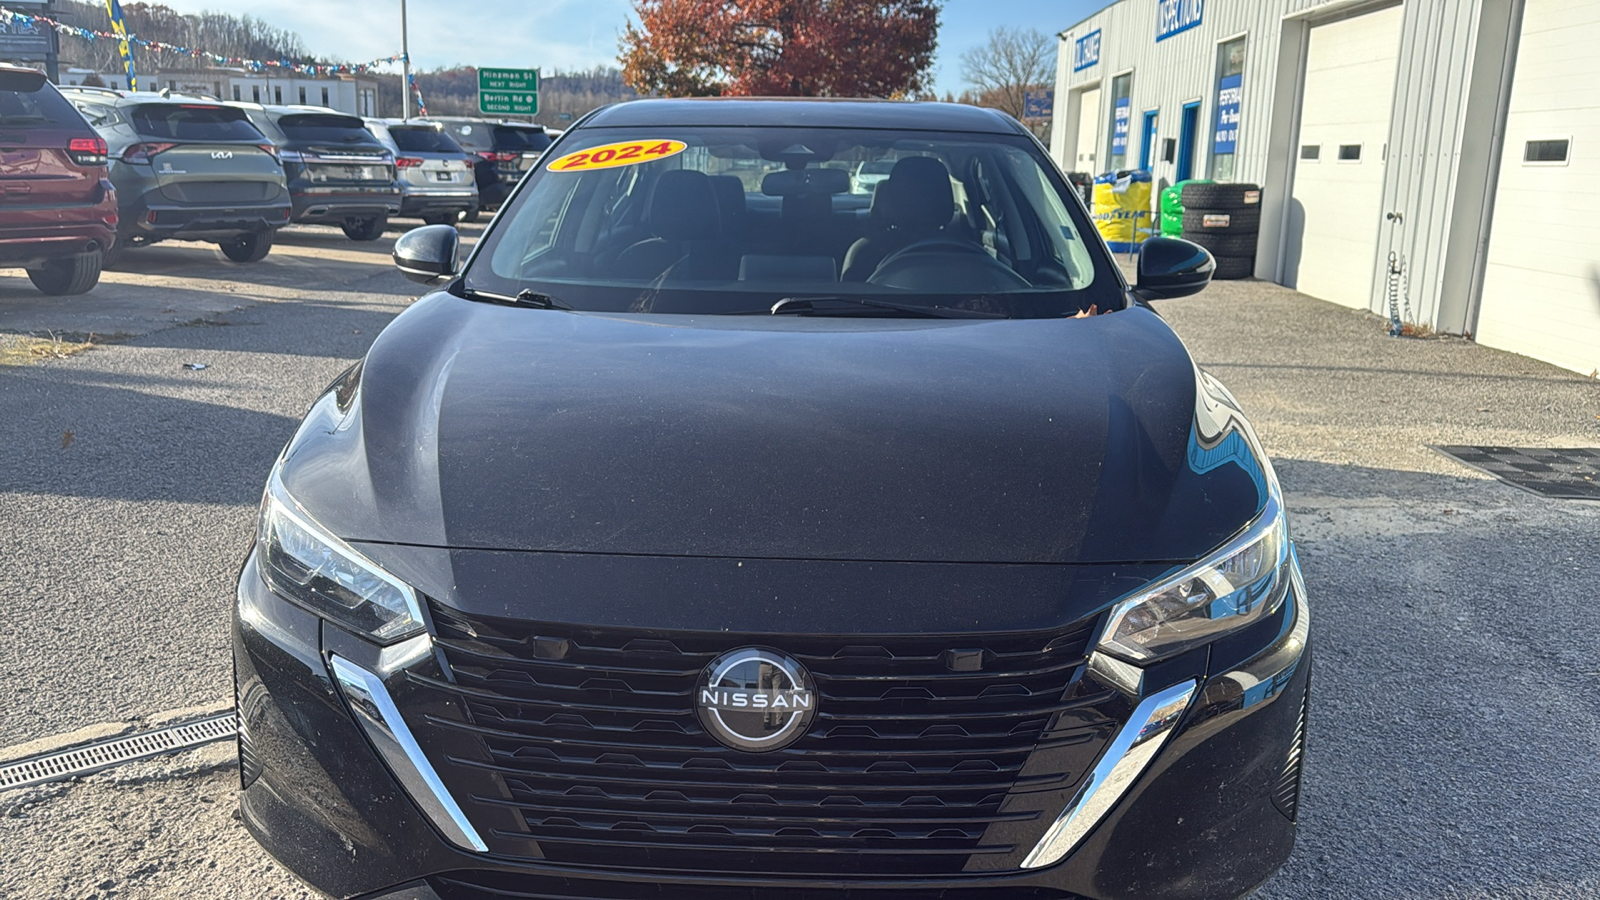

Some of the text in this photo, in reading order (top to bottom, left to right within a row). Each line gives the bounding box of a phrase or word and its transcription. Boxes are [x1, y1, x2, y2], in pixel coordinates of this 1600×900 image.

[484, 94, 509, 102] Berlin
[512, 95, 523, 103] Rd
[211, 151, 233, 159] KIA
[562, 141, 673, 169] 2024
[702, 689, 809, 708] NISSAN
